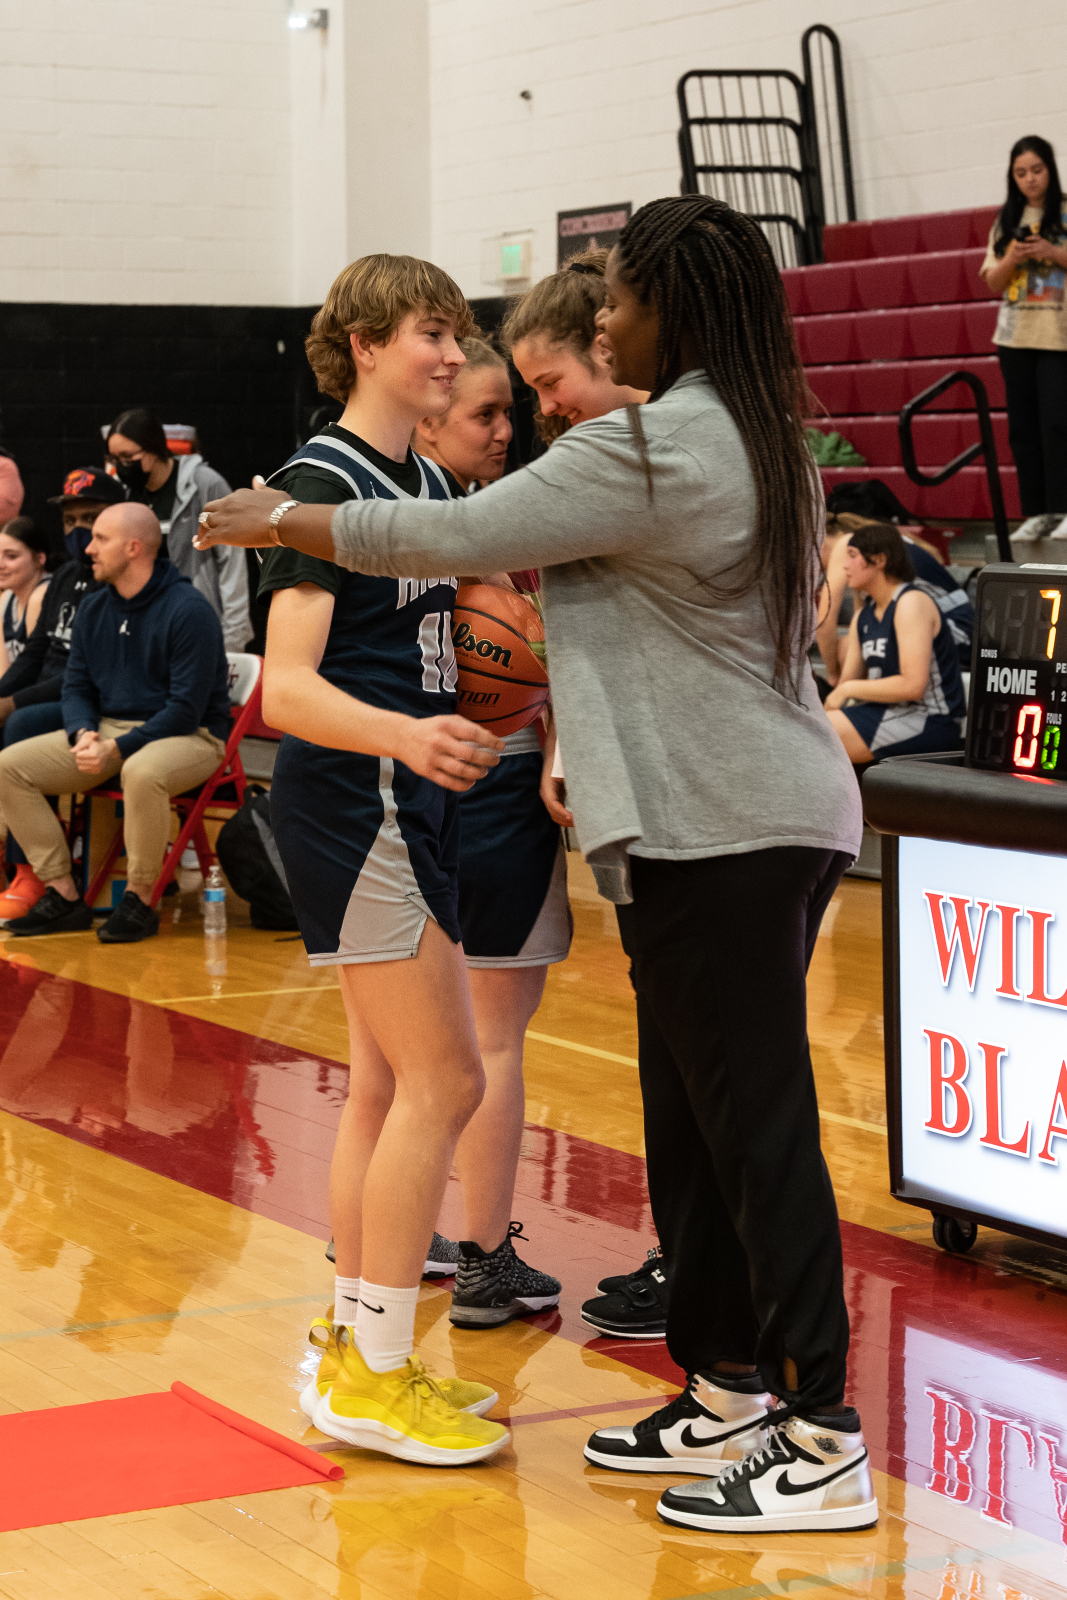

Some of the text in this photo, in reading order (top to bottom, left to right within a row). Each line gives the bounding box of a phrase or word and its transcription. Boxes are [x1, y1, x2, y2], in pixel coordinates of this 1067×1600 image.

[1039, 589, 1062, 660] 7
[451, 621, 512, 669] lson
[980, 648, 998, 659] BONUS
[986, 666, 1037, 696] HOME
[1050, 690, 1067, 702] 1 2
[1013, 704, 1042, 768] 0
[1046, 712, 1063, 725] FOULS
[1040, 725, 1061, 770] 0
